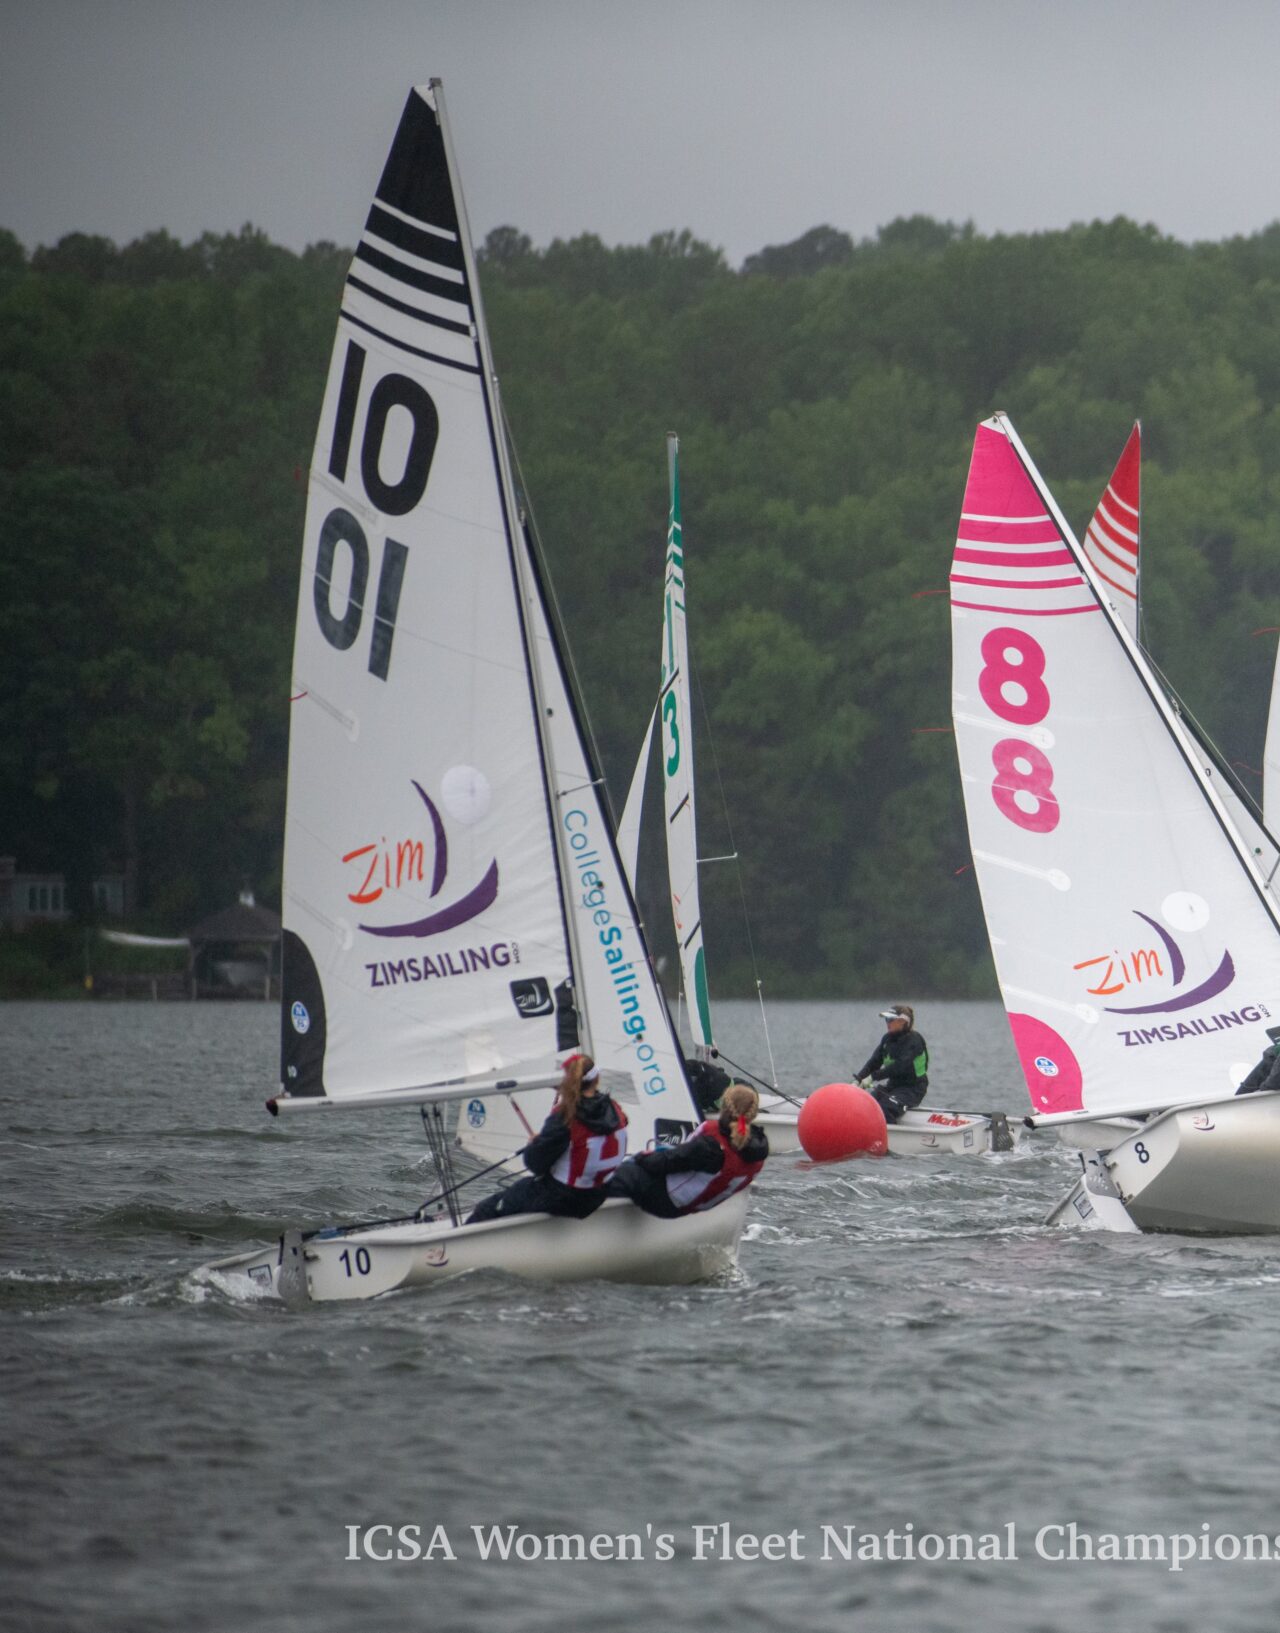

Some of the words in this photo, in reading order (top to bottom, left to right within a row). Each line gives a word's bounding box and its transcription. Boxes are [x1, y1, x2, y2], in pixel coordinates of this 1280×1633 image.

[328, 339, 439, 516] 10
[979, 627, 1050, 726] 8
[662, 690, 680, 776] 3
[365, 942, 512, 987] ZIMSAILING
[563, 809, 668, 1097] CollegeSailing.org
[1117, 1005, 1263, 1047] ZIMSAILING
[1134, 1141, 1150, 1164] 8
[339, 1247, 371, 1278] 10
